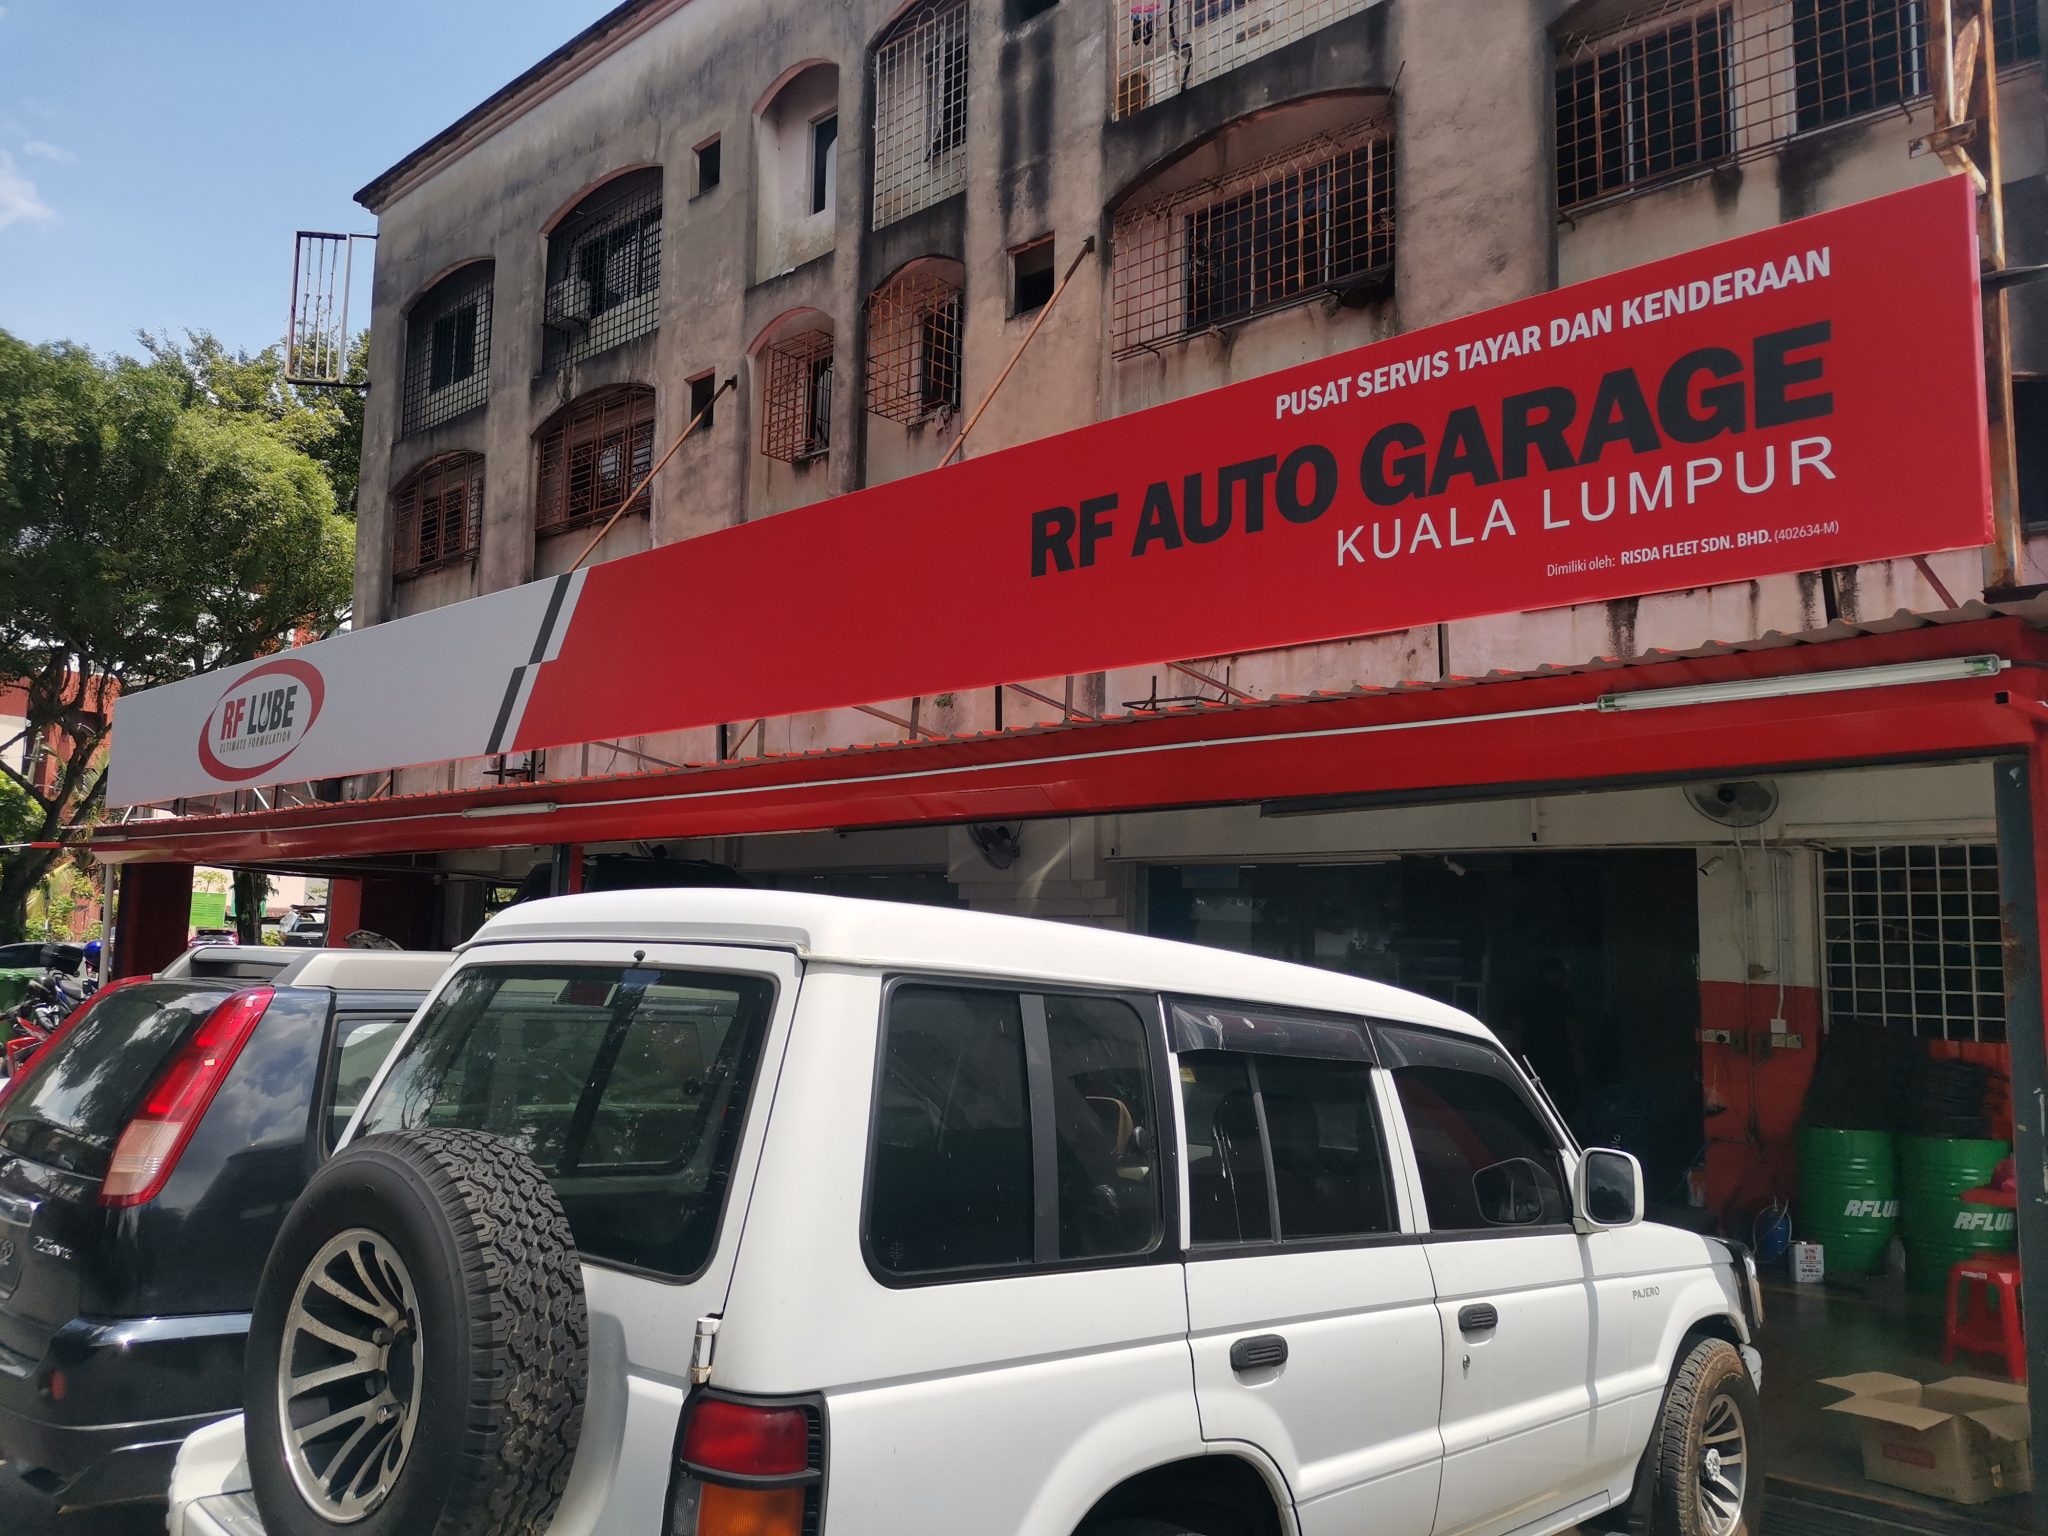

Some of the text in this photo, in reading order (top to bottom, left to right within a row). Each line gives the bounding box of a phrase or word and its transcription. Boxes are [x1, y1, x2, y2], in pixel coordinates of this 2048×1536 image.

[1276, 246, 1830, 419] PUSAT SERVIS TAYAR DAN KENDERAAN
[1031, 320, 1834, 577] RF AUTO GARAGE
[1337, 435, 1836, 566] KUALA LUMPUR
[1547, 520, 1839, 577] Dimiliki oleh: RISDA FLEET SDN. BHD. (402634-M)
[221, 685, 298, 740] RF LUBE
[219, 730, 291, 754] ULTIMATE FORMULATION
[1632, 1286, 1660, 1300] PAJERO
